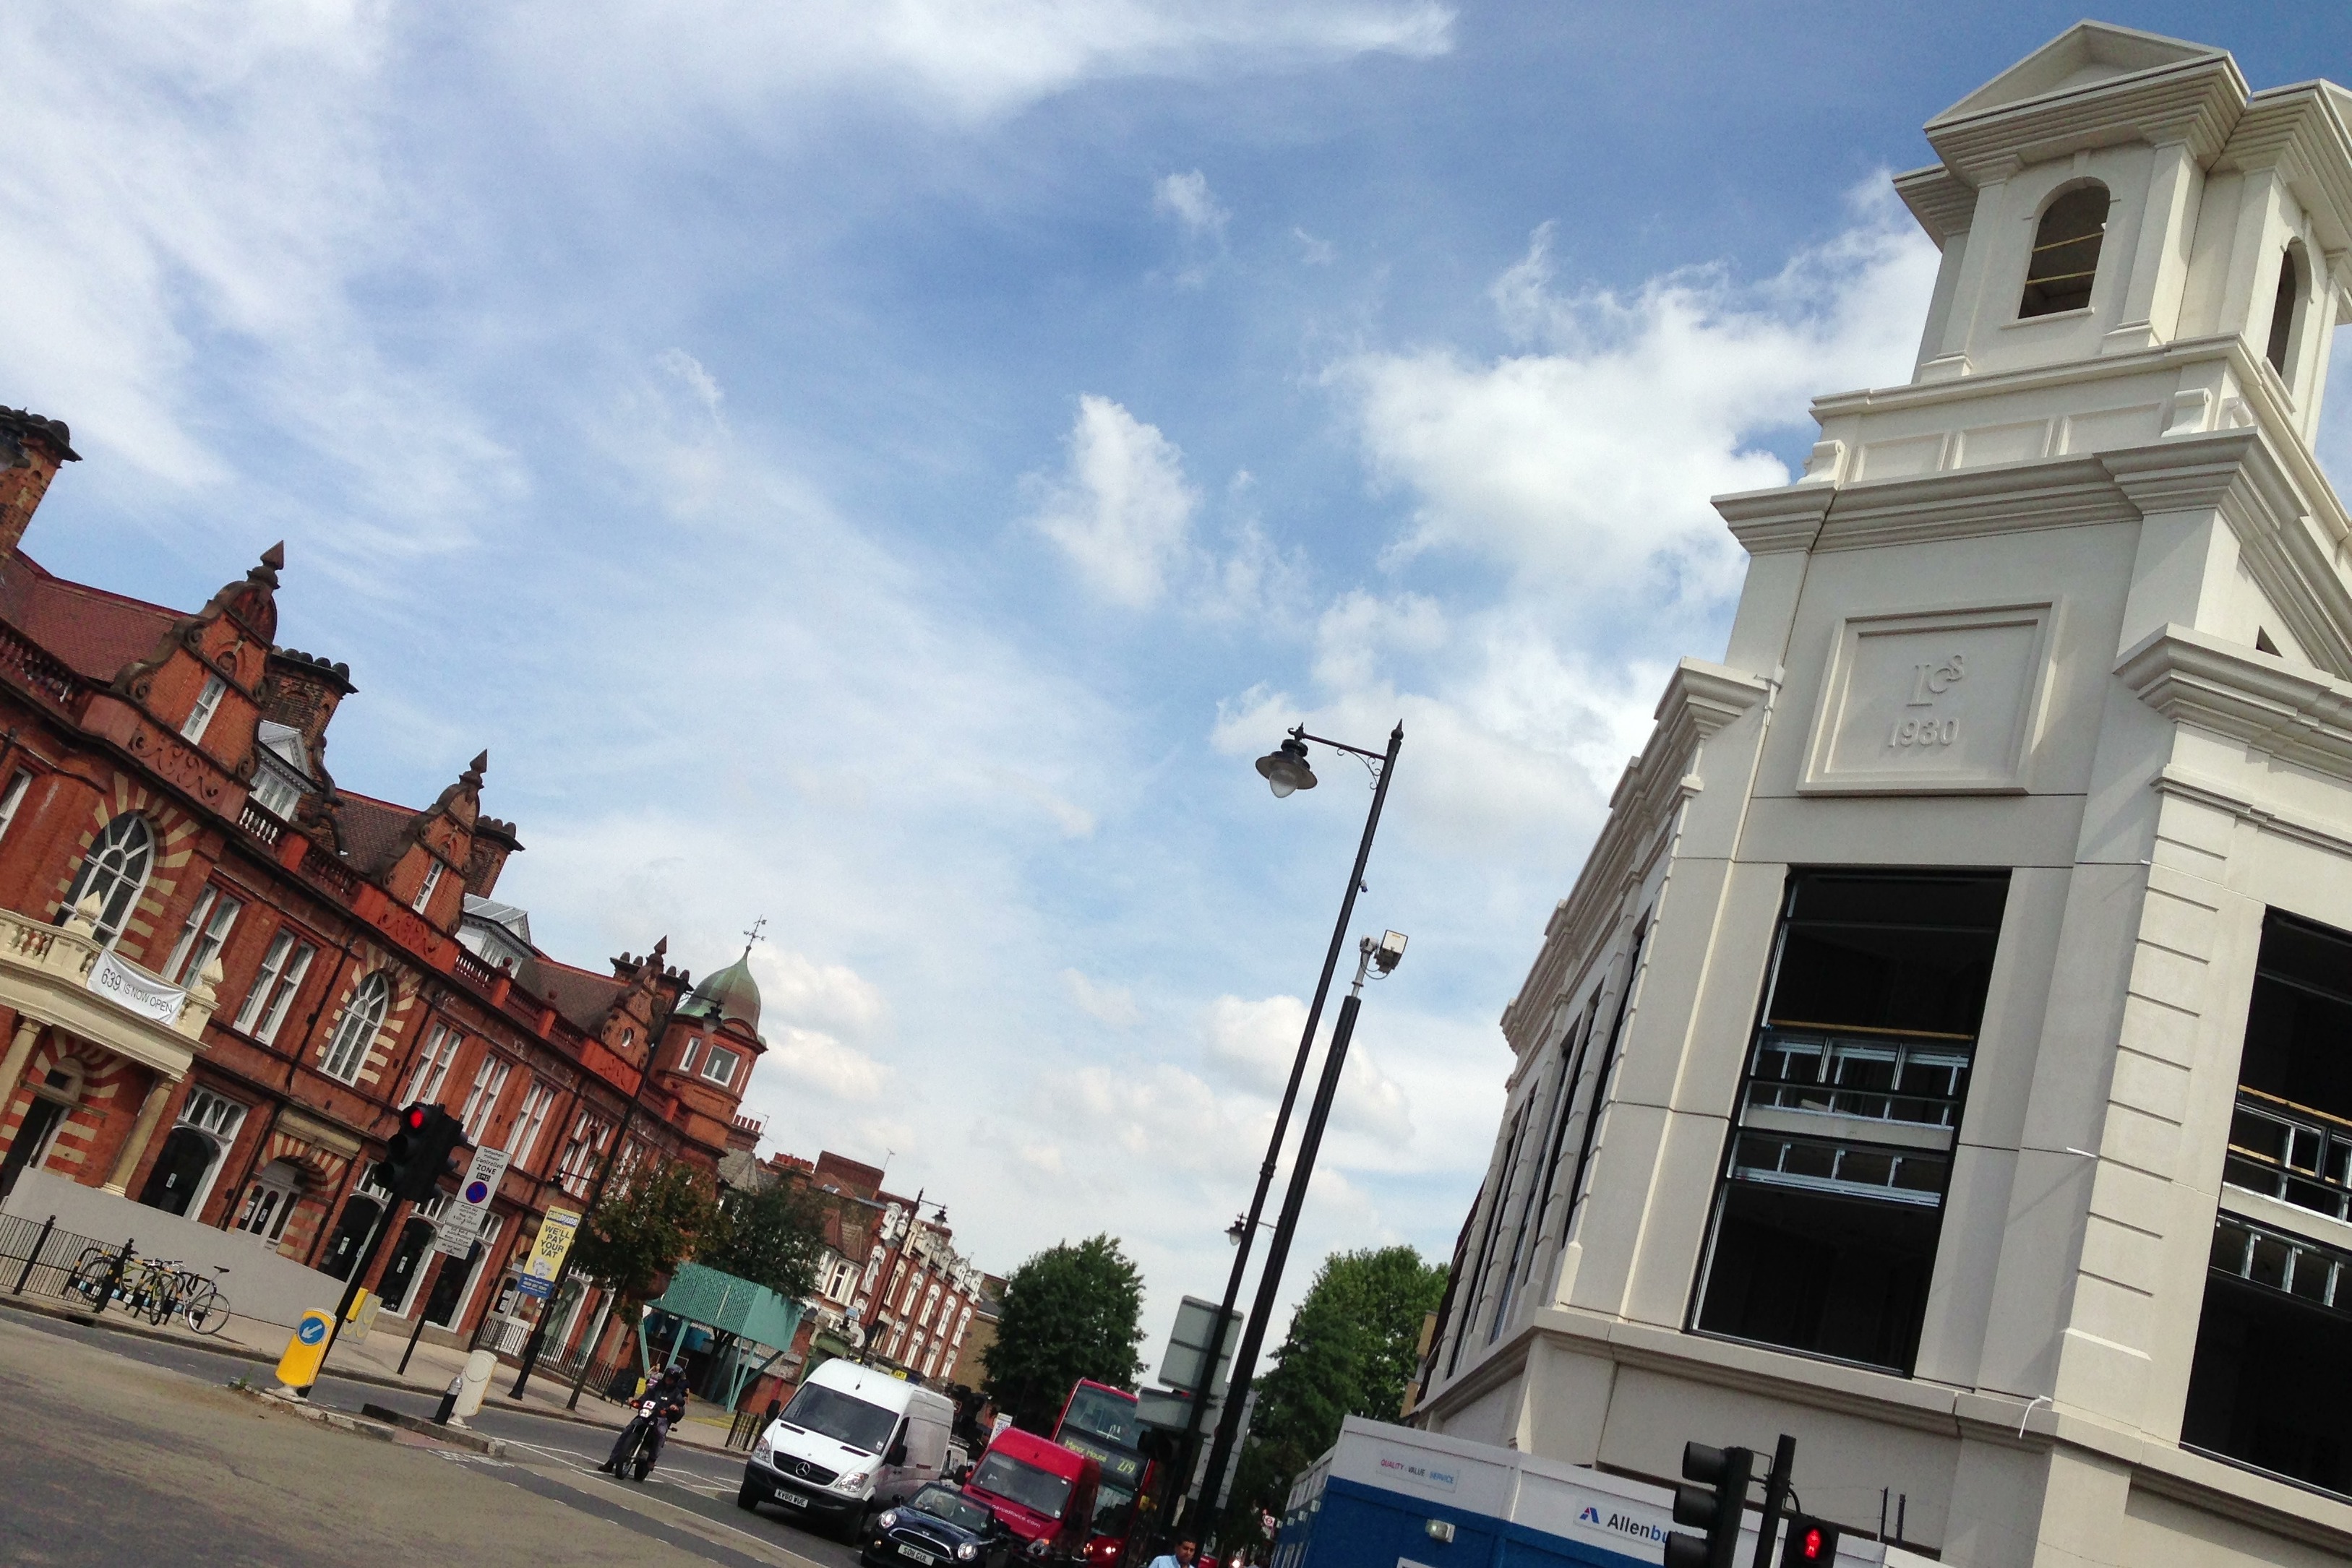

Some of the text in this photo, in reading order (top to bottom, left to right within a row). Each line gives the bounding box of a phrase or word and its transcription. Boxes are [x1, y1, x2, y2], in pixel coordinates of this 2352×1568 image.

[1887, 718, 1960, 748] 1930
[101, 968, 173, 1013] 639 IS NOW OPEN
[476, 1157, 504, 1169] Controlled
[476, 1163, 497, 1175] ZONE
[545, 1225, 570, 1239] WE'LL
[546, 1233, 565, 1244] PAY
[541, 1239, 565, 1253] YOUR
[541, 1248, 558, 1259] VAT
[1065, 1439, 1136, 1474] Manor House 279
[1381, 1459, 1454, 1484] QUALITY VALUE SERVICE
